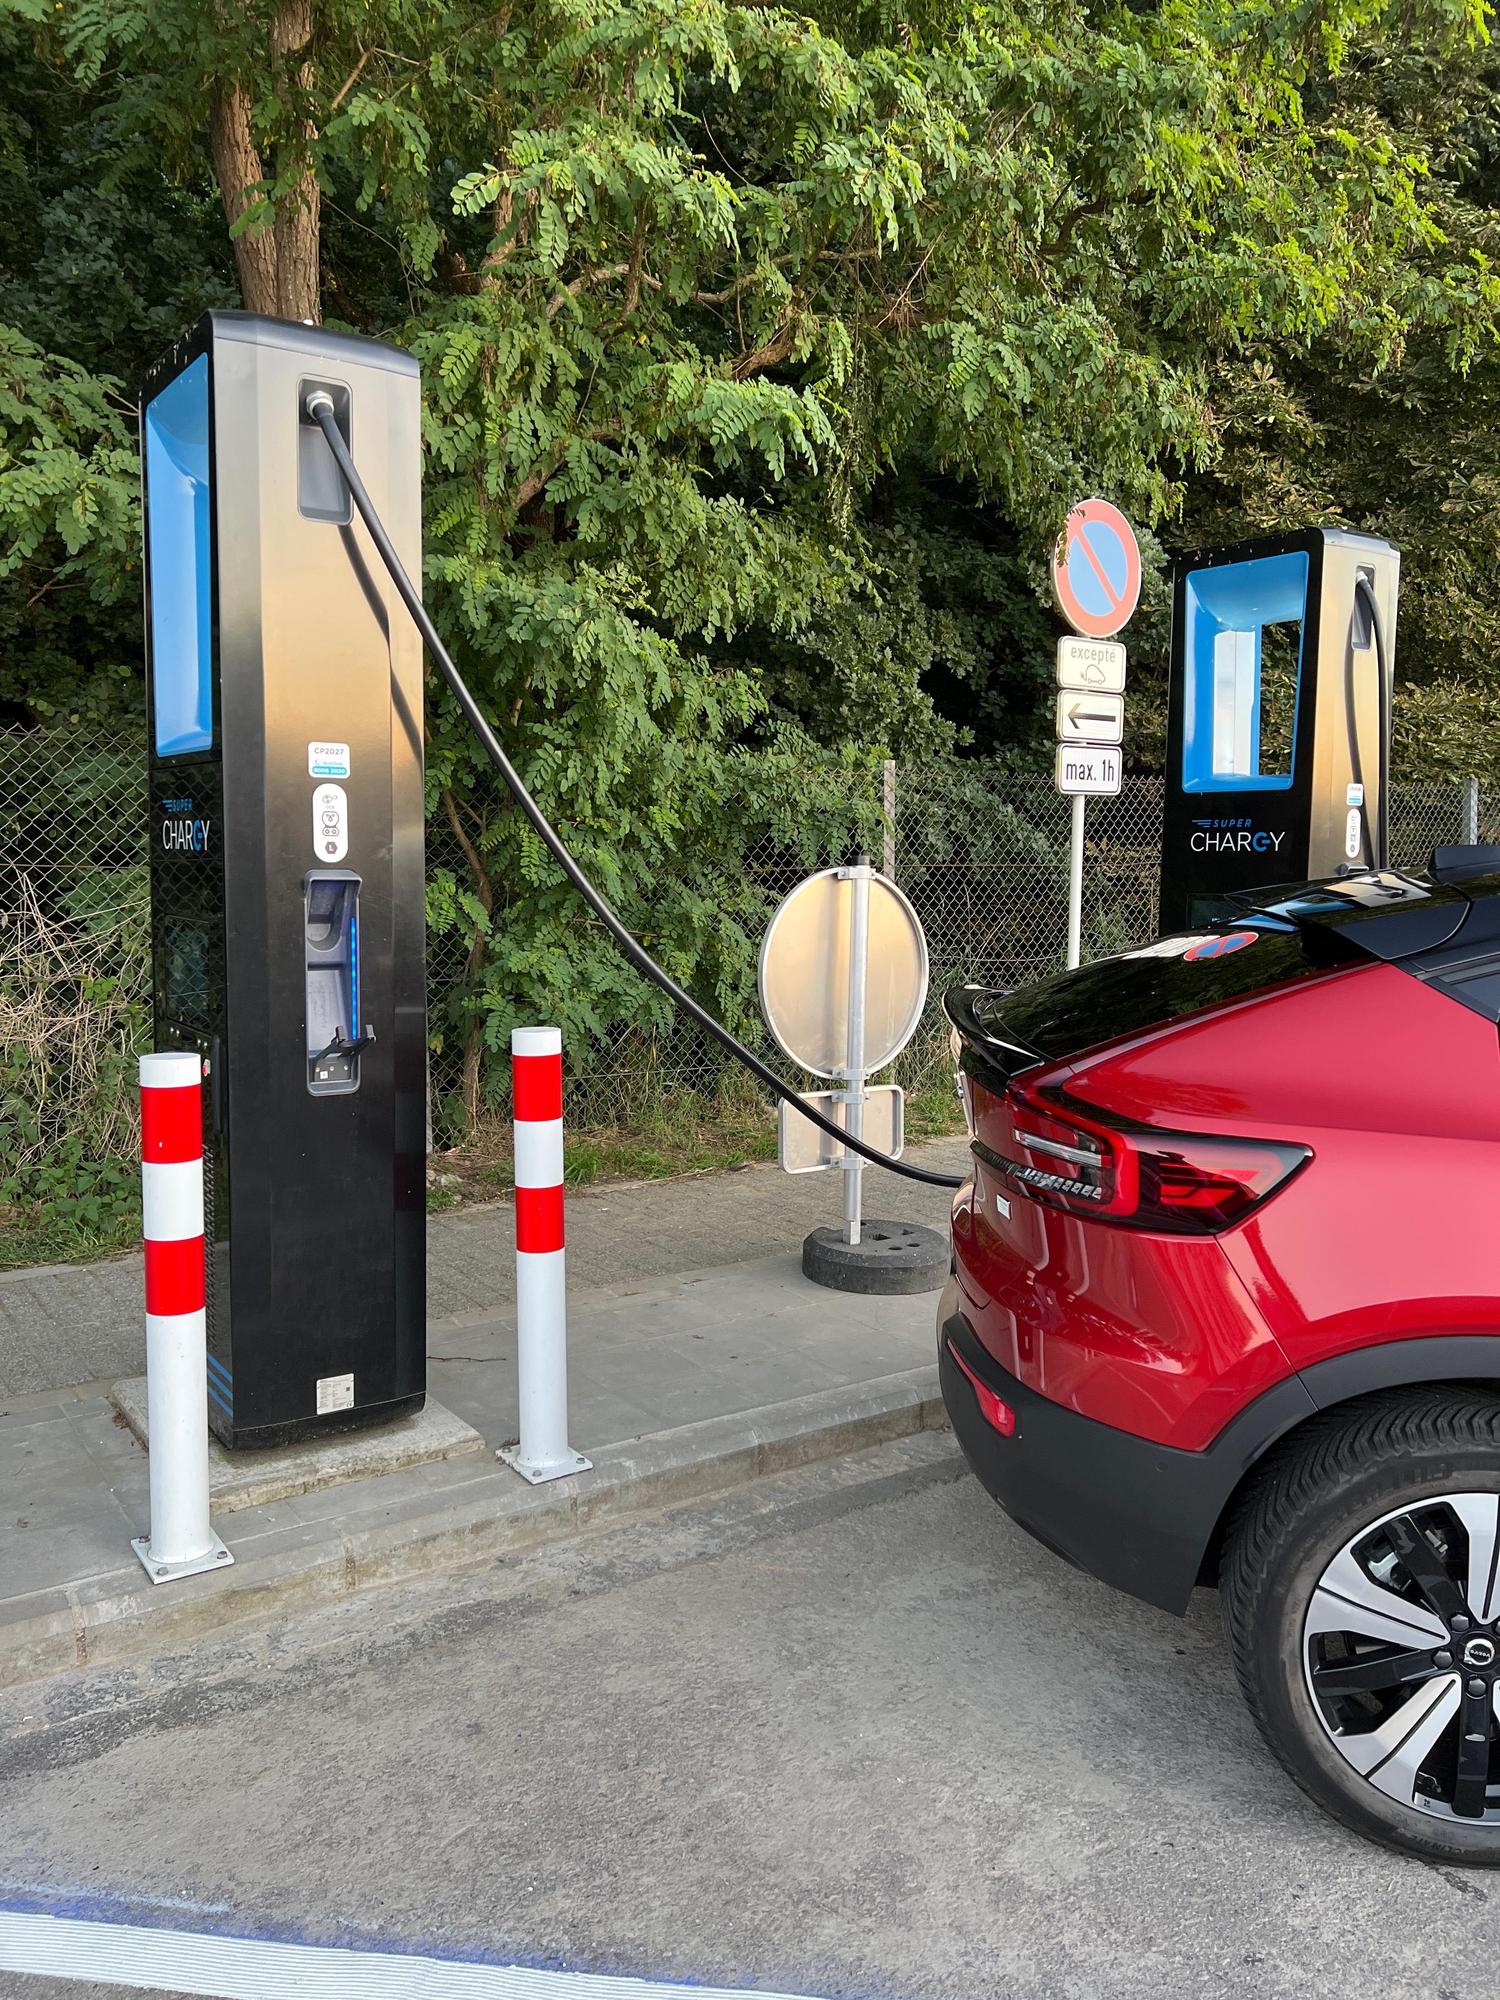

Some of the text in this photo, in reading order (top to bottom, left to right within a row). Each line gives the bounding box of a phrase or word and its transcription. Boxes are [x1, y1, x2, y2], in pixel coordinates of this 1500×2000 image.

[1070, 645, 1116, 665] excepté
[313, 747, 345, 756] CP2027
[1065, 759, 1115, 782] max. 1h
[1213, 818, 1252, 828] SUPER
[162, 820, 210, 852] CHARGY
[1190, 831, 1286, 852] CHARGY
[1470, 1649, 1490, 1658] VOLVO
